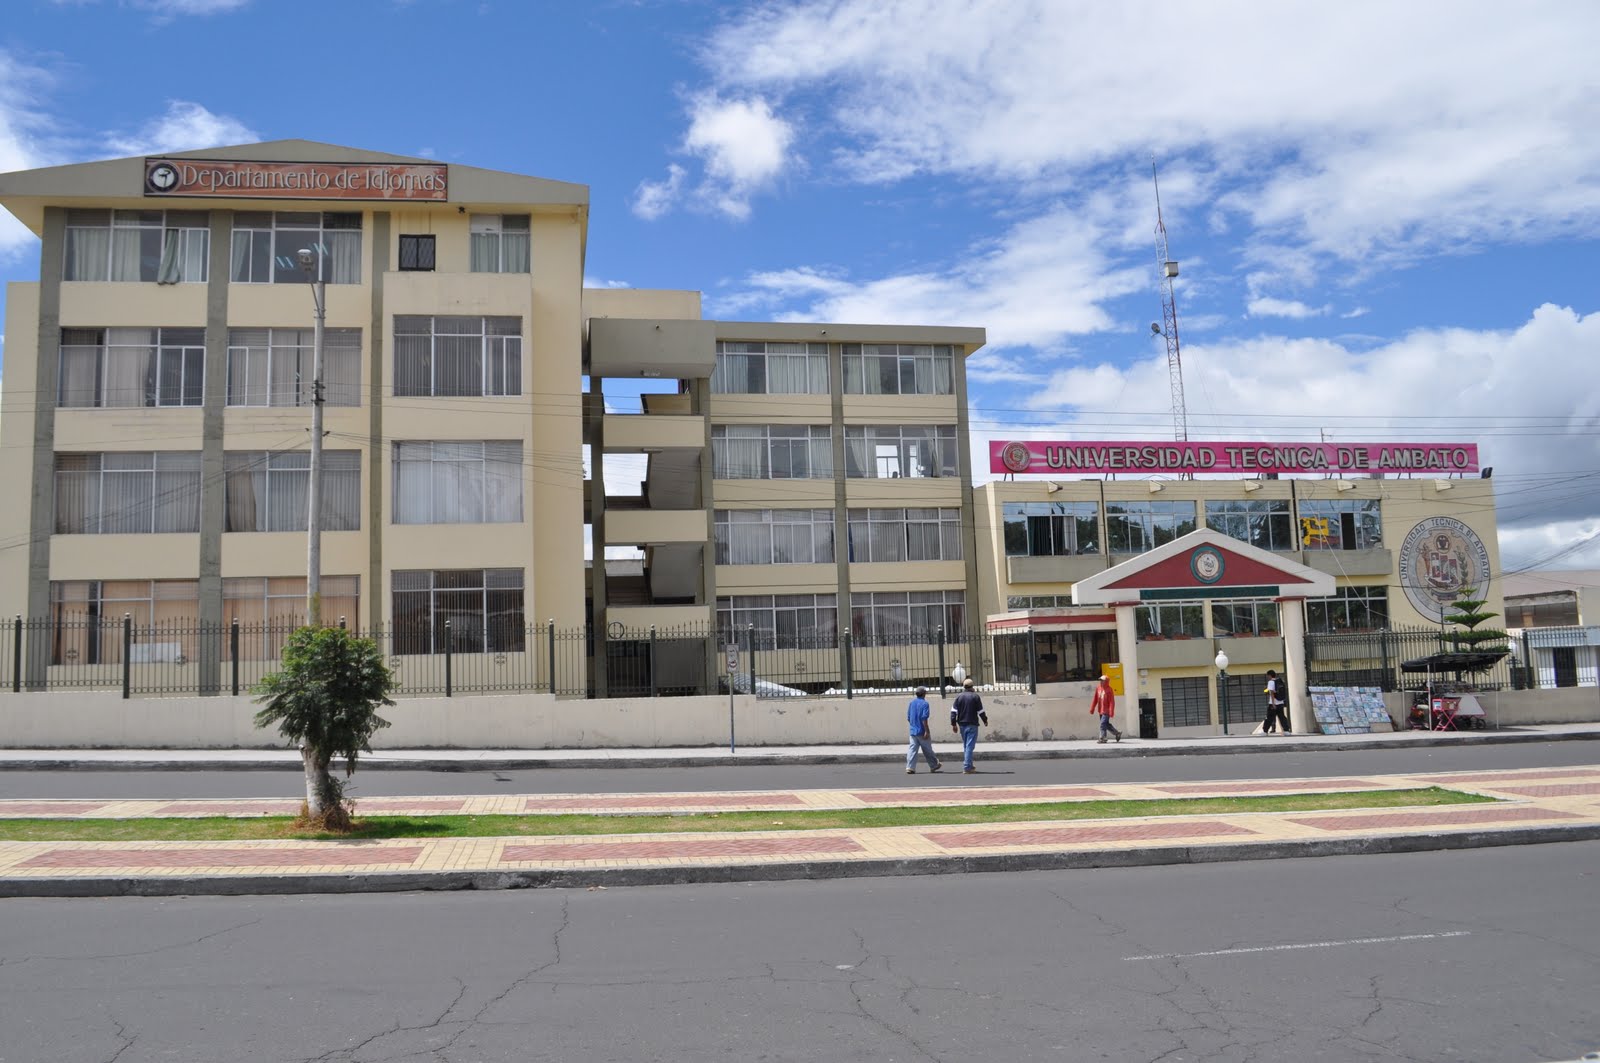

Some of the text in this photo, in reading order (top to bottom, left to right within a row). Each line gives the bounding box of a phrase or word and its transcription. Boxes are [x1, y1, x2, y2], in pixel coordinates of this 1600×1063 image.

[182, 165, 447, 192] Departamento de Idiomas
[1046, 446, 1217, 469] UNIVERSIDAD
[1225, 447, 1330, 469] TECNICA
[1338, 447, 1370, 469] DE
[1378, 447, 1470, 469] AMBATO
[1400, 524, 1426, 579] UNIVERSIDAD
[1431, 518, 1464, 531] TECNICA
[1474, 539, 1490, 578] AMBATO
